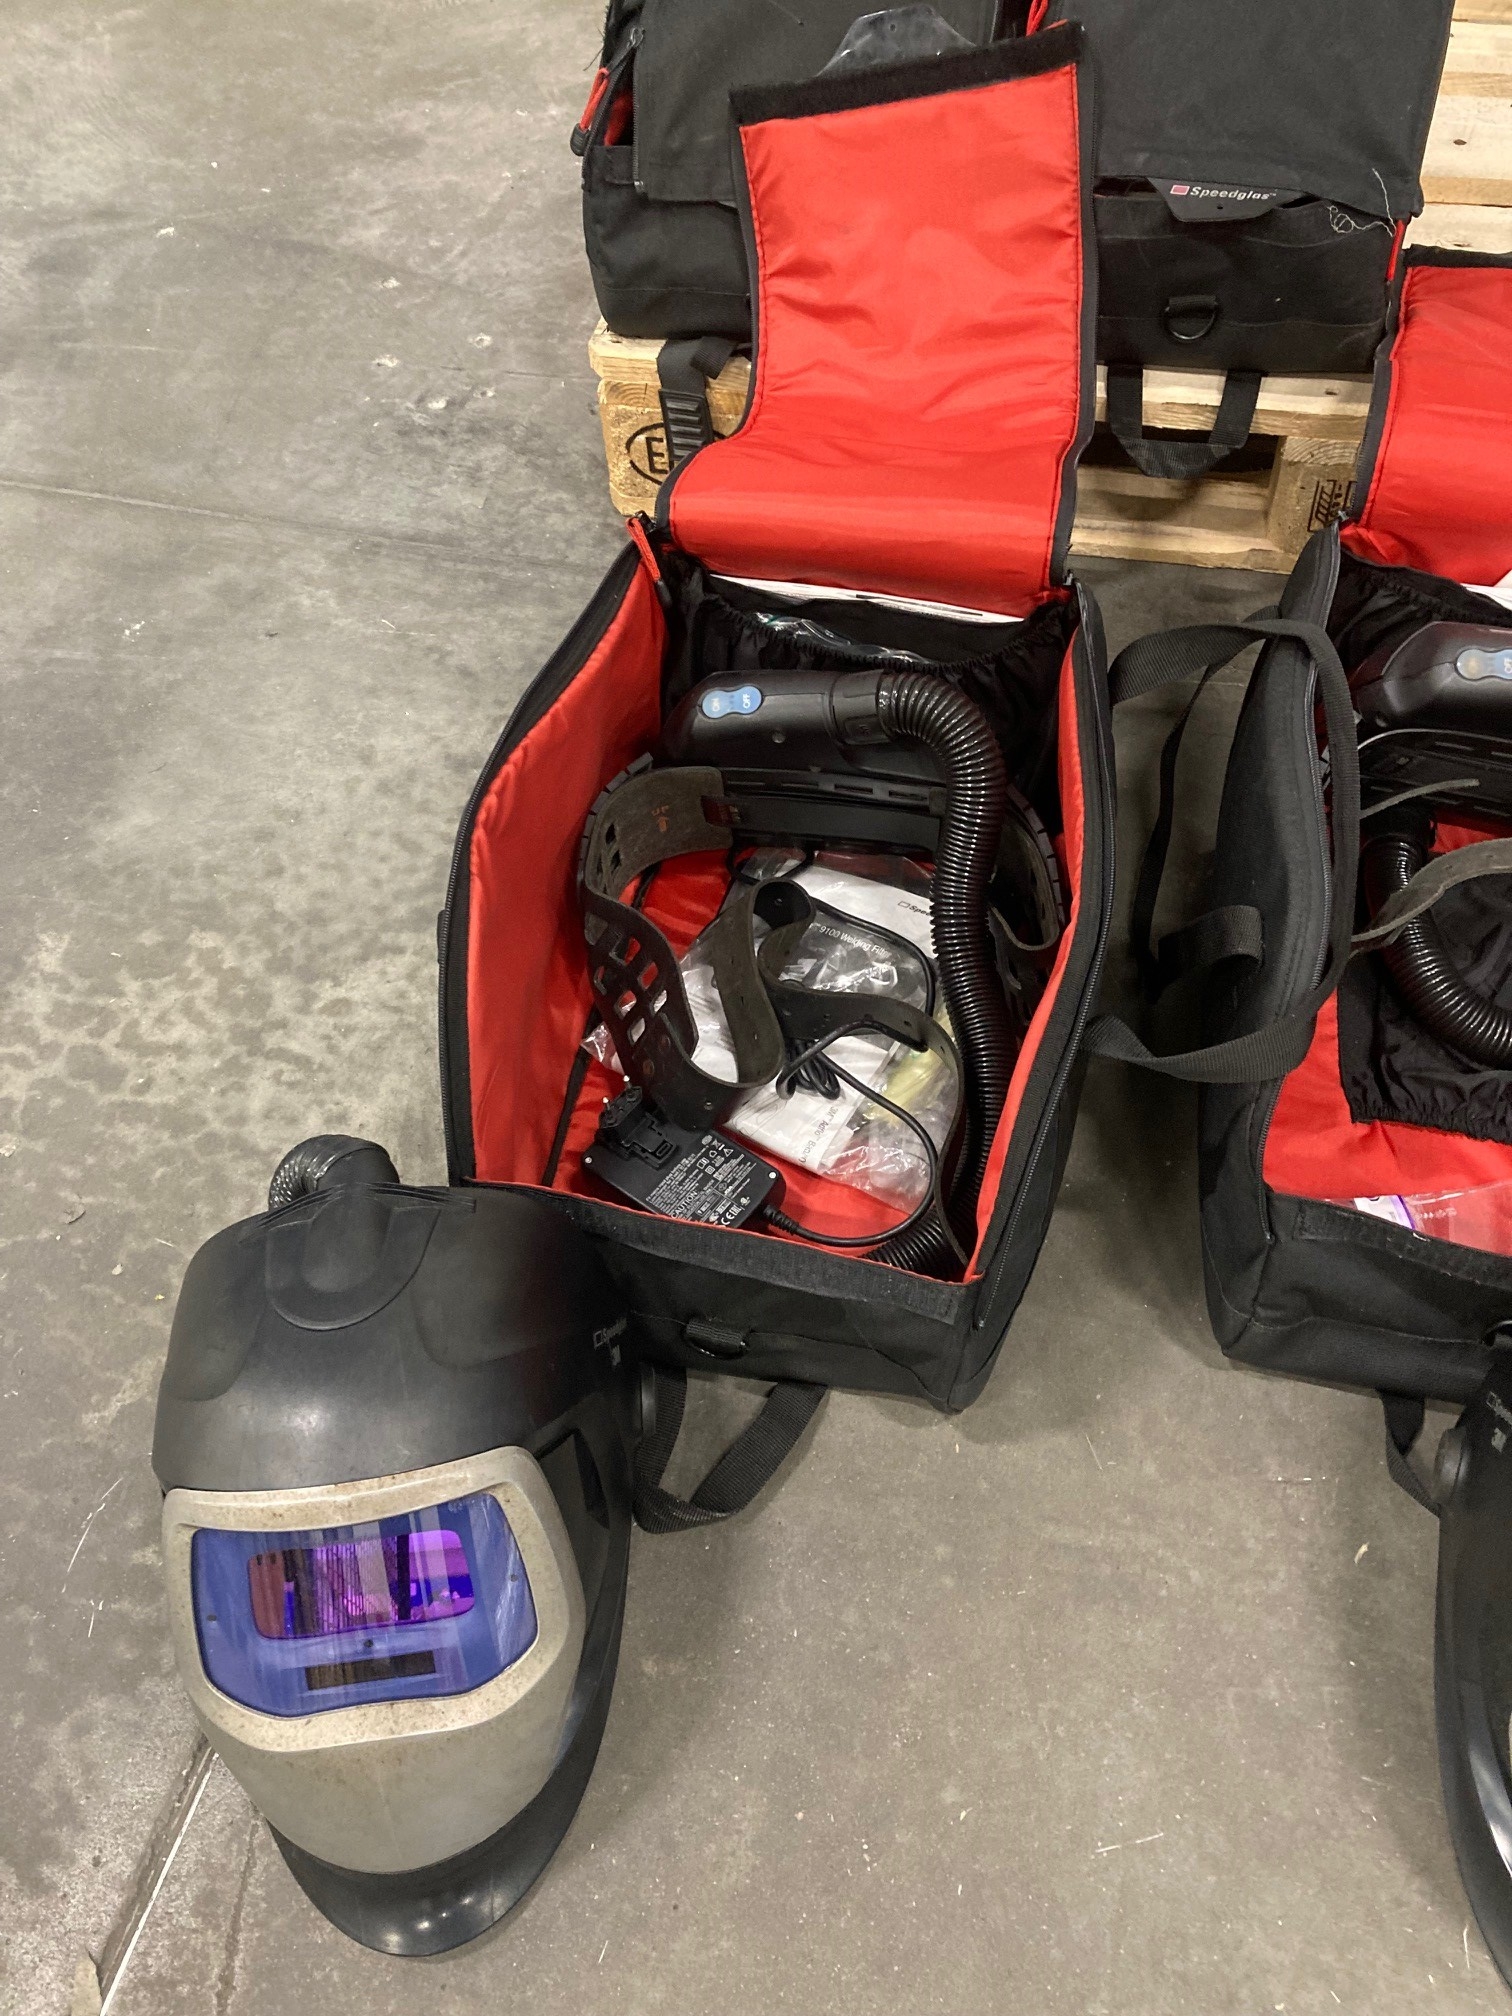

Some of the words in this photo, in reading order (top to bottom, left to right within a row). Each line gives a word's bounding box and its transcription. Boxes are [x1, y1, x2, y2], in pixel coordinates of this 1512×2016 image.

[742, 693, 751, 709] OFF
[819, 925, 841, 938] 9100
[840, 932, 872, 951] Welding
